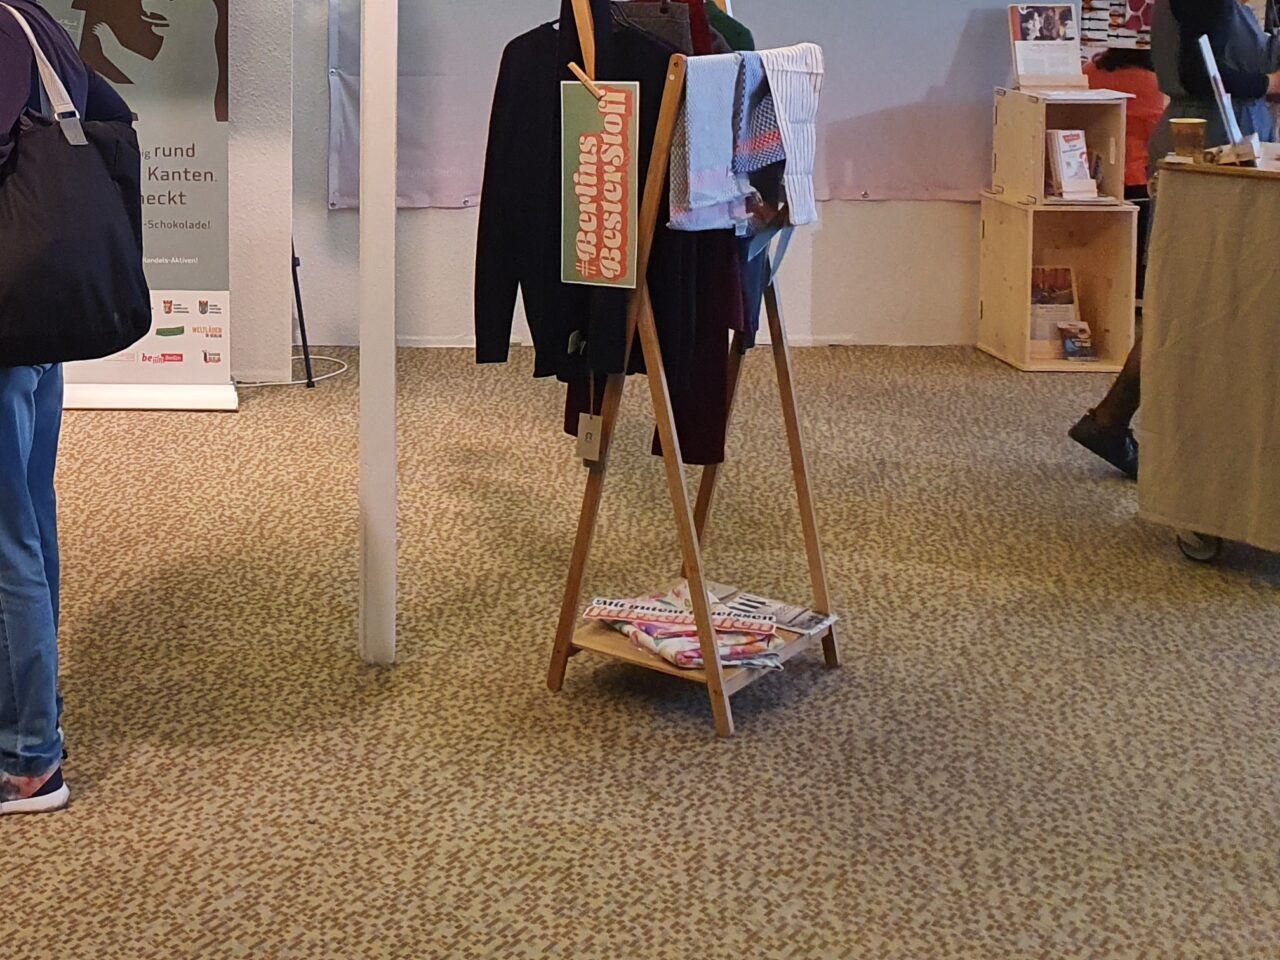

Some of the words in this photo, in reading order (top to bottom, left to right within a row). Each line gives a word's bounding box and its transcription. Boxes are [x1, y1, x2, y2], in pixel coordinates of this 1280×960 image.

[154, 143, 195, 158] rund
[140, 190, 187, 206] eckt
[144, 220, 211, 230] -Schokolade!
